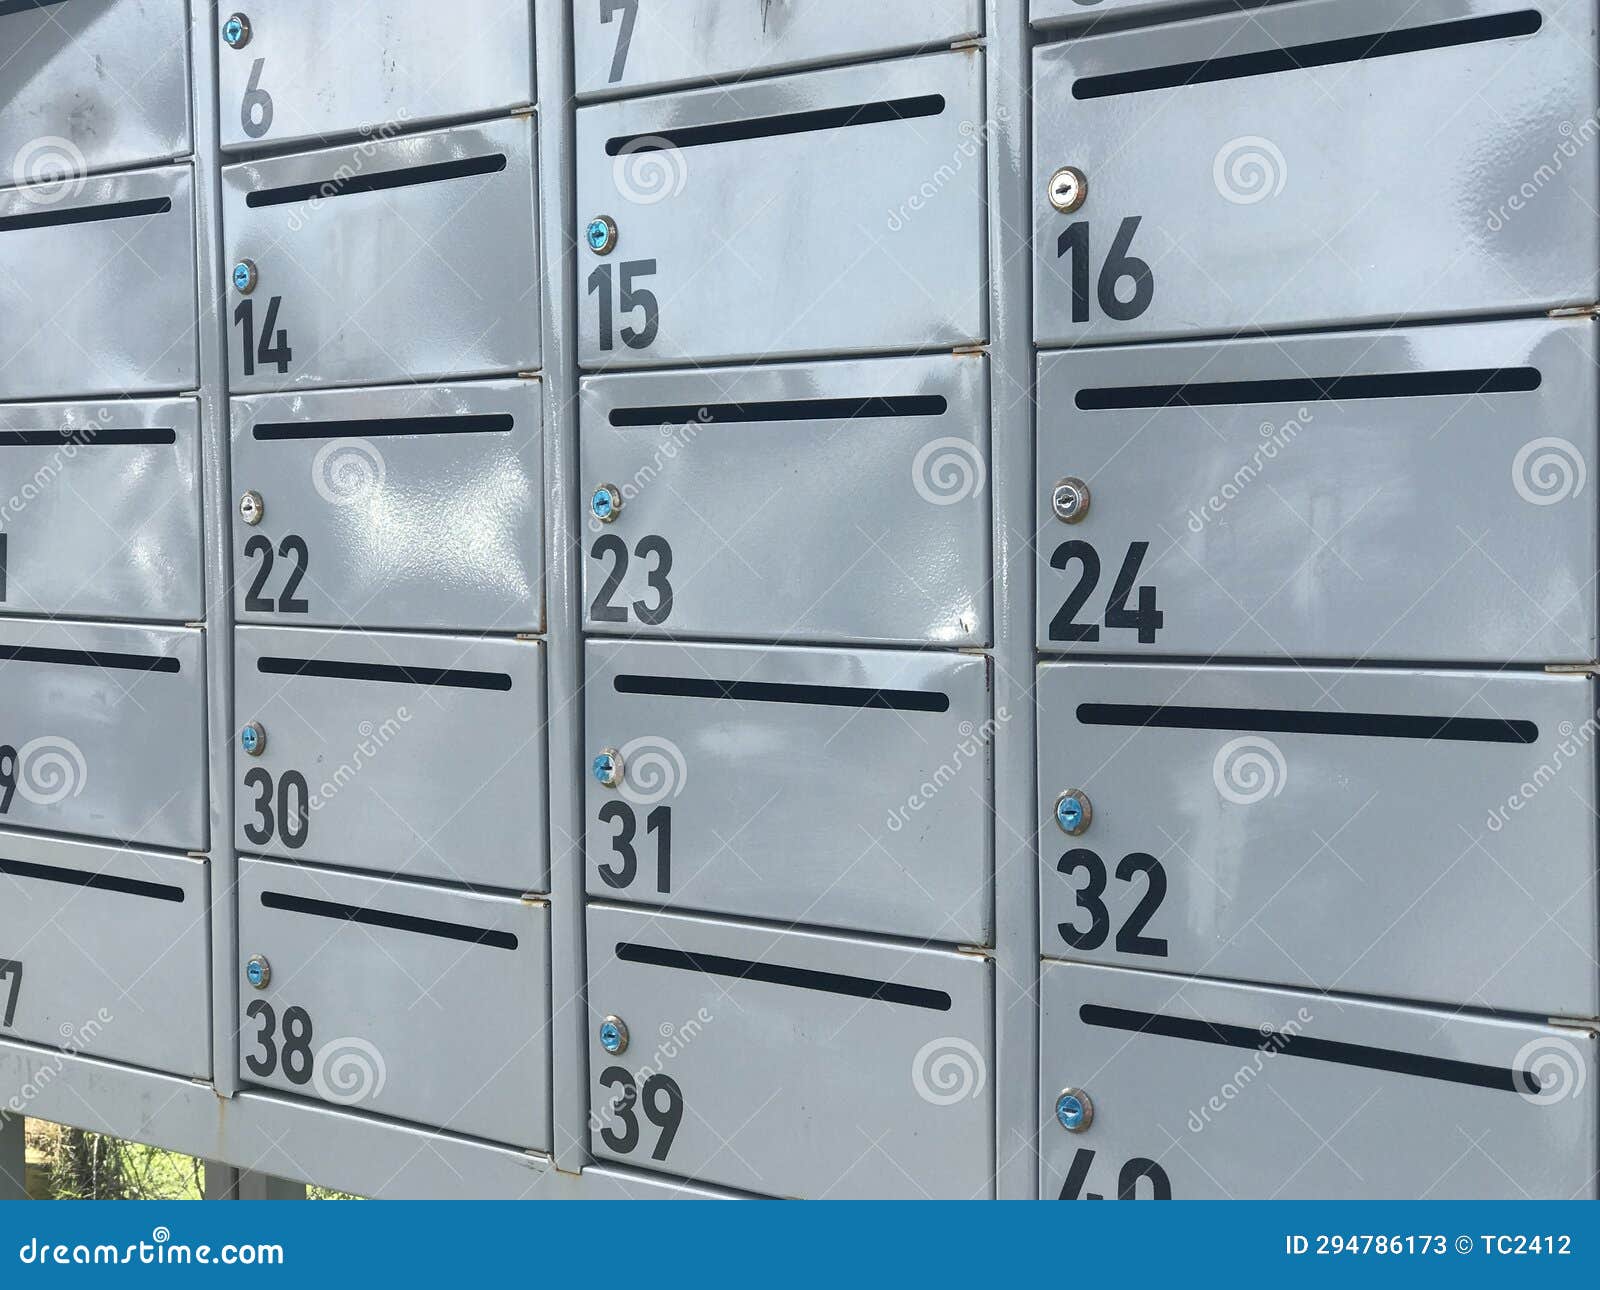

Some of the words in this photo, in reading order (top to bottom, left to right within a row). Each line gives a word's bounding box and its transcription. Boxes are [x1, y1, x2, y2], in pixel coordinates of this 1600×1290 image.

[600, 0, 638, 83] 7
[241, 58, 273, 139] 6
[588, 259, 658, 351] 15
[1057, 216, 1153, 323] 16
[235, 296, 292, 375] 14
[244, 535, 308, 613] 22
[591, 534, 673, 625] 23
[1049, 540, 1163, 643] 24
[244, 767, 308, 849] 30
[598, 800, 671, 893] 31
[1057, 849, 1168, 957] 32
[245, 999, 313, 1086] 38
[599, 1066, 683, 1161] 39
